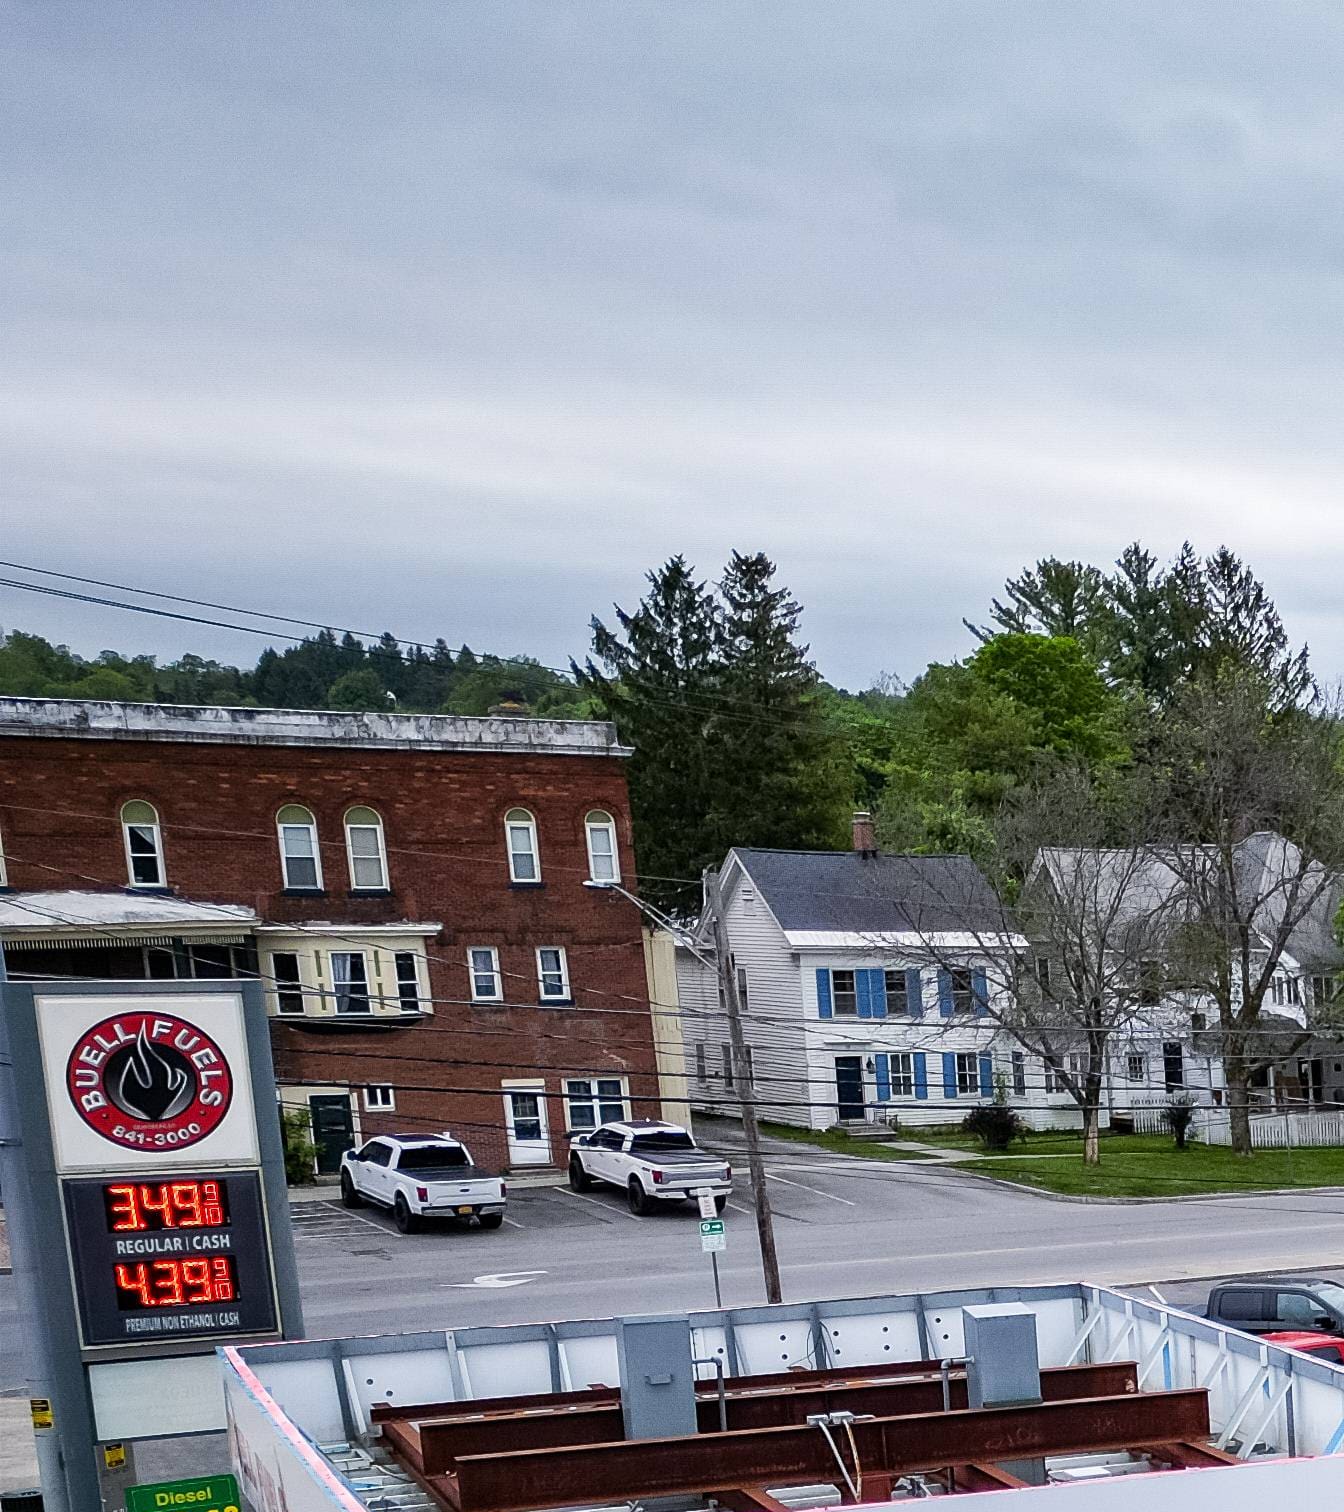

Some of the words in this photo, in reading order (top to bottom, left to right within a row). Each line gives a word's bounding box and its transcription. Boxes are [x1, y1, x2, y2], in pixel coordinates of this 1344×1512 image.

[76, 1022, 138, 1113] BUELL
[151, 1020, 223, 1108] FUELS
[112, 1123, 201, 1146] 841-3000
[116, 1238, 182, 1254] REGULAR
[192, 1234, 231, 1250] CASH
[161, 1316, 180, 1330] NON
[180, 1314, 215, 1329] ETHANOL
[219, 1311, 240, 1326] CASH
[155, 1486, 212, 1506] Diesel
